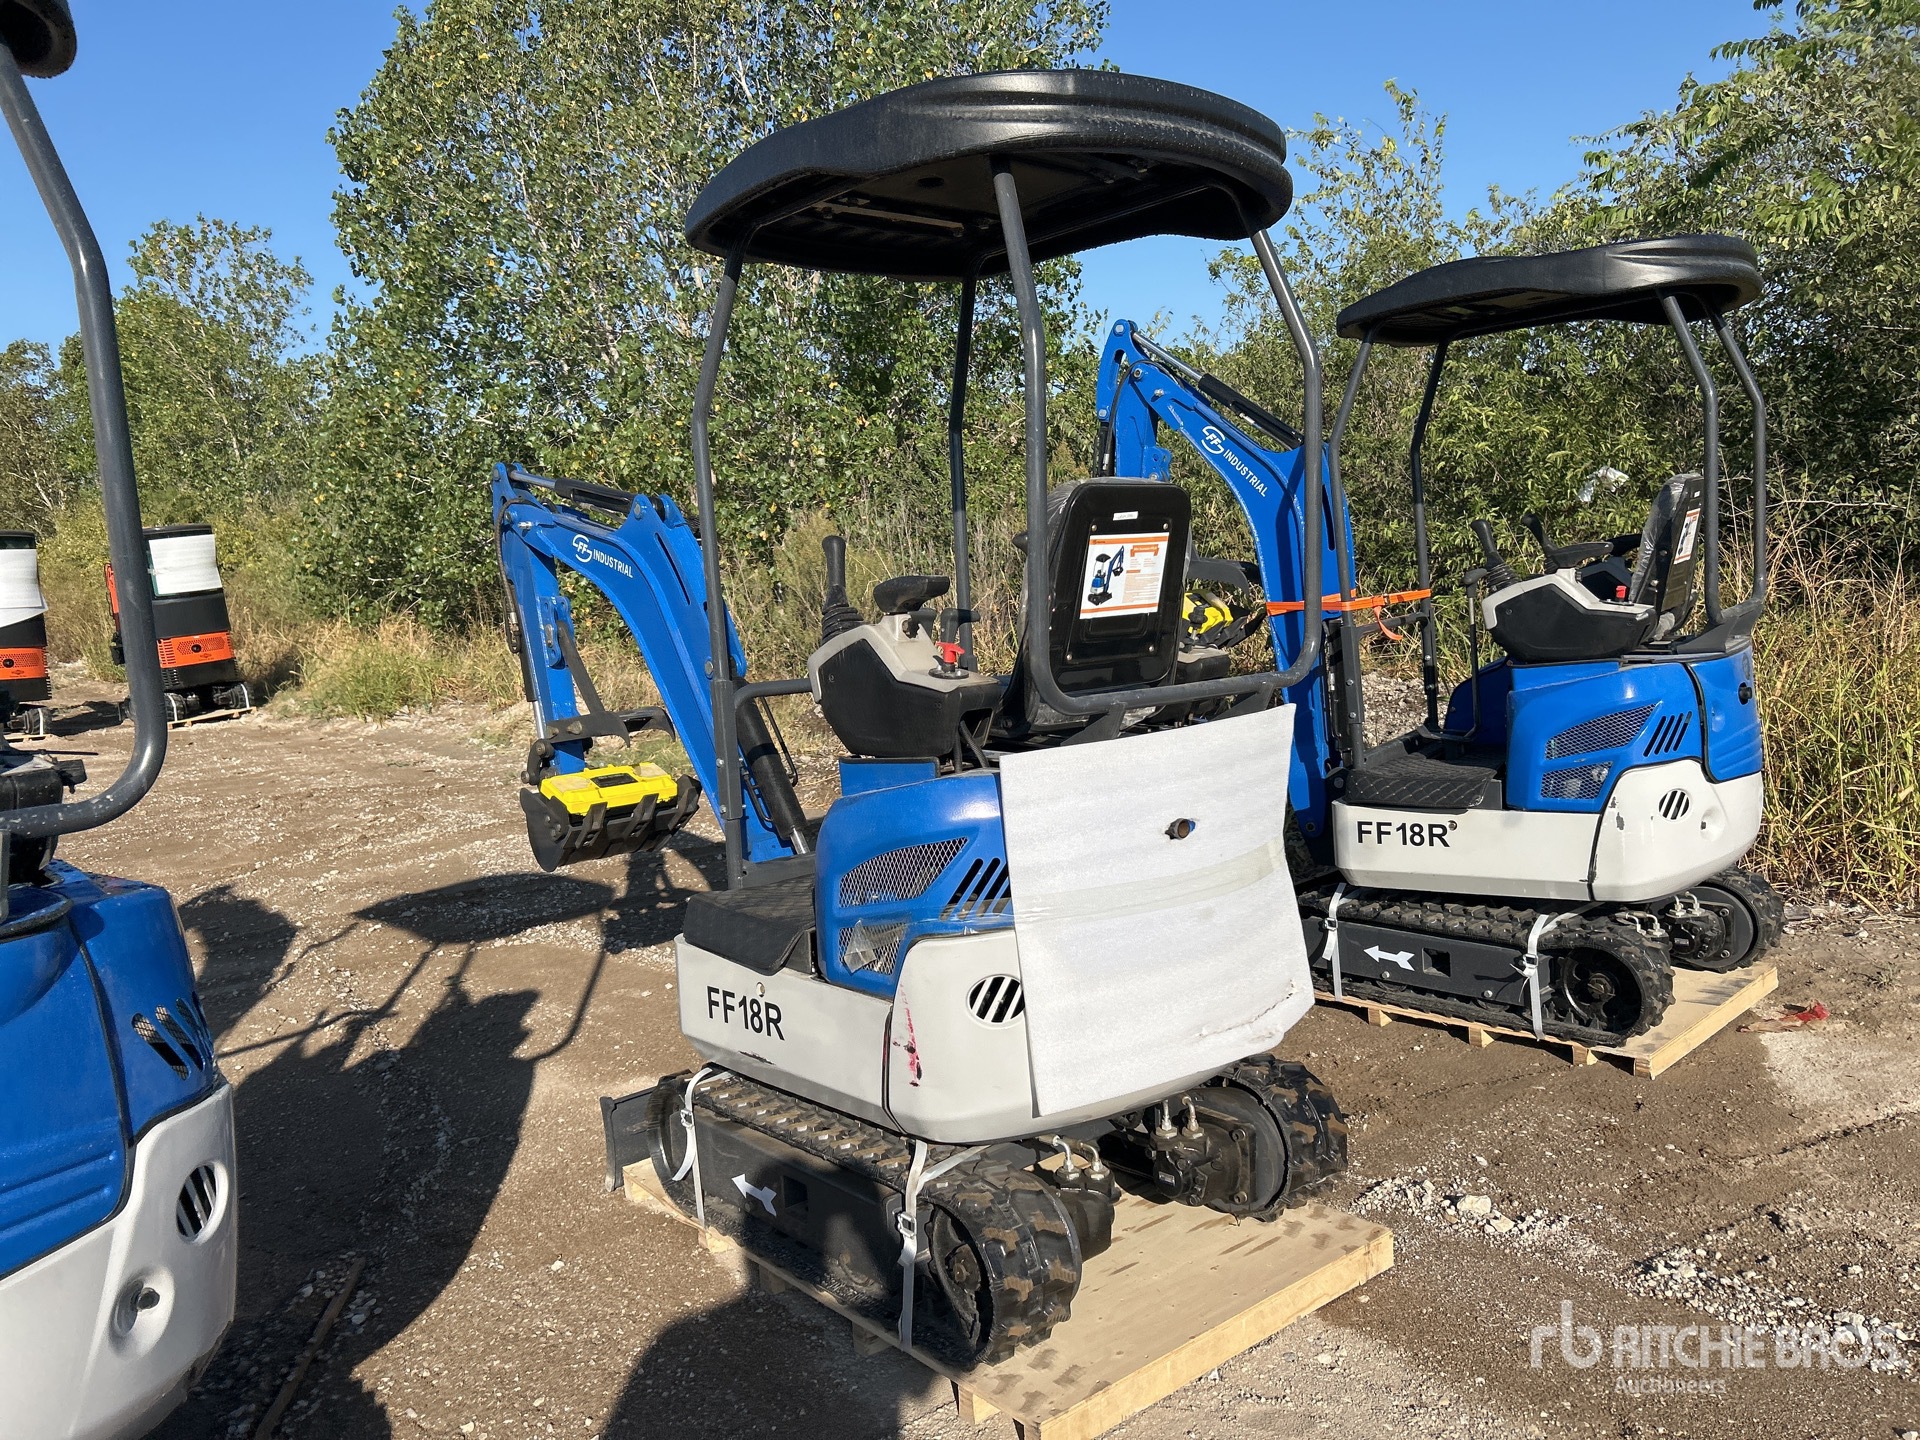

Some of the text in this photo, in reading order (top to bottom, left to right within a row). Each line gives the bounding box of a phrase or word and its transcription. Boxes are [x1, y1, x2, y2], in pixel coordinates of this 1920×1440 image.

[1223, 449, 1269, 498] INDUSTRIAL
[593, 548, 634, 579] INDUSTRIAL
[1357, 821, 1450, 847] FF18R
[706, 985, 786, 1041] FF18R
